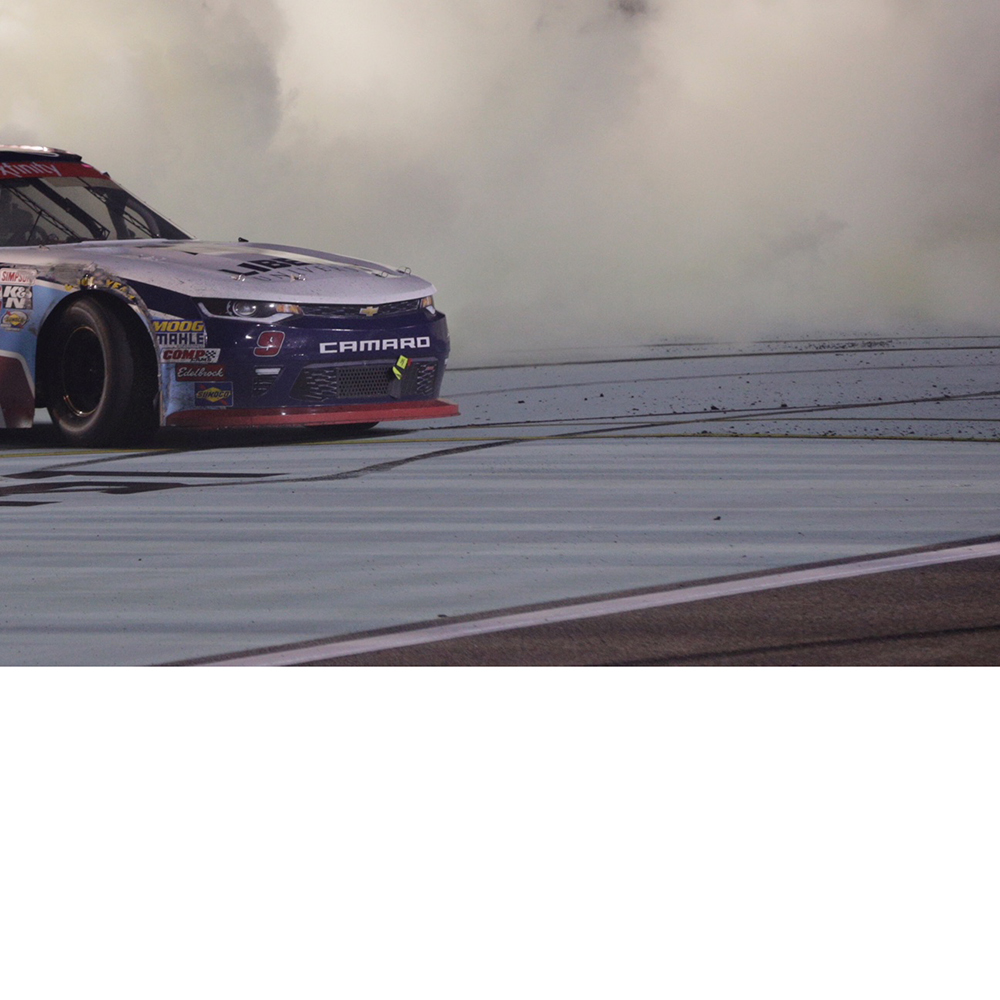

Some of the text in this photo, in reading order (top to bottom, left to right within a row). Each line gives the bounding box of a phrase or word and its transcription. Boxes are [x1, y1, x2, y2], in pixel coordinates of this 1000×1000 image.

[153, 320, 205, 333] MOOG
[155, 333, 205, 345] MAHLE
[253, 331, 286, 358] 9
[319, 336, 430, 354] CAMARO
[163, 350, 206, 360] COMP
[177, 366, 224, 378] Edelbrock
[196, 390, 231, 399] SUNOCO
